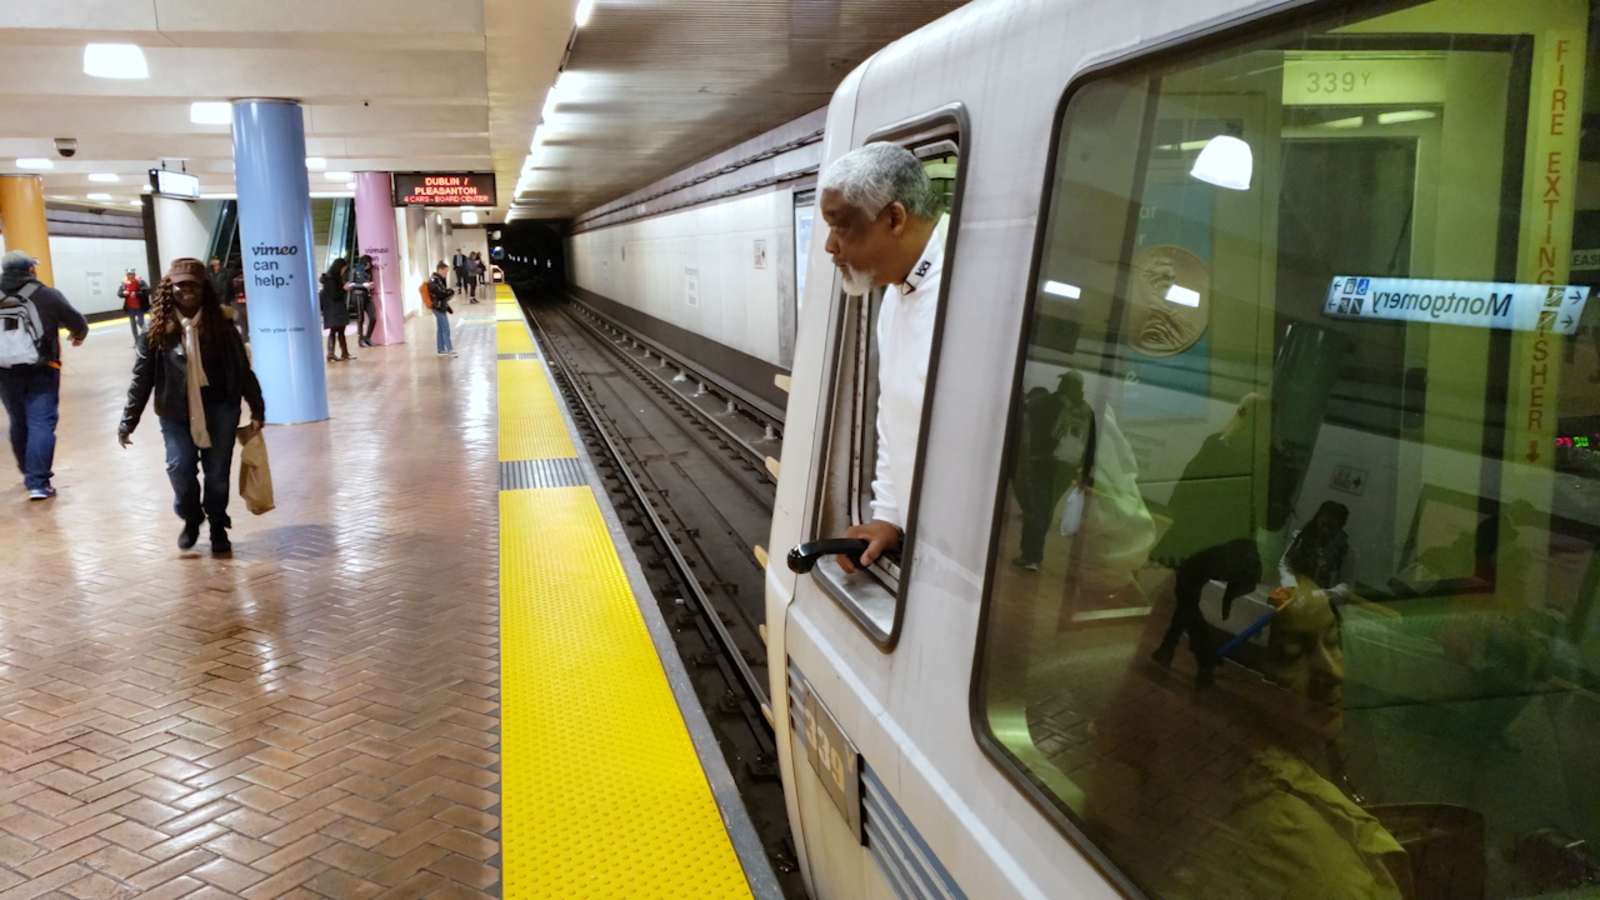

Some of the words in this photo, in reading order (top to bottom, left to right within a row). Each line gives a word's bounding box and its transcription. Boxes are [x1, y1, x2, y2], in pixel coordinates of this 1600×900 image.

[1550, 39, 1570, 136] FIRE
[424, 177, 460, 186] DUBLIN
[414, 186, 477, 196] PLEASANTON
[403, 195, 409, 203] 4
[410, 195, 430, 203] CARS
[434, 195, 460, 203] BOARD
[460, 195, 489, 203] CENTER
[251, 241, 298, 256] vimeo
[364, 246, 389, 254] vimeo
[253, 261, 279, 271] can
